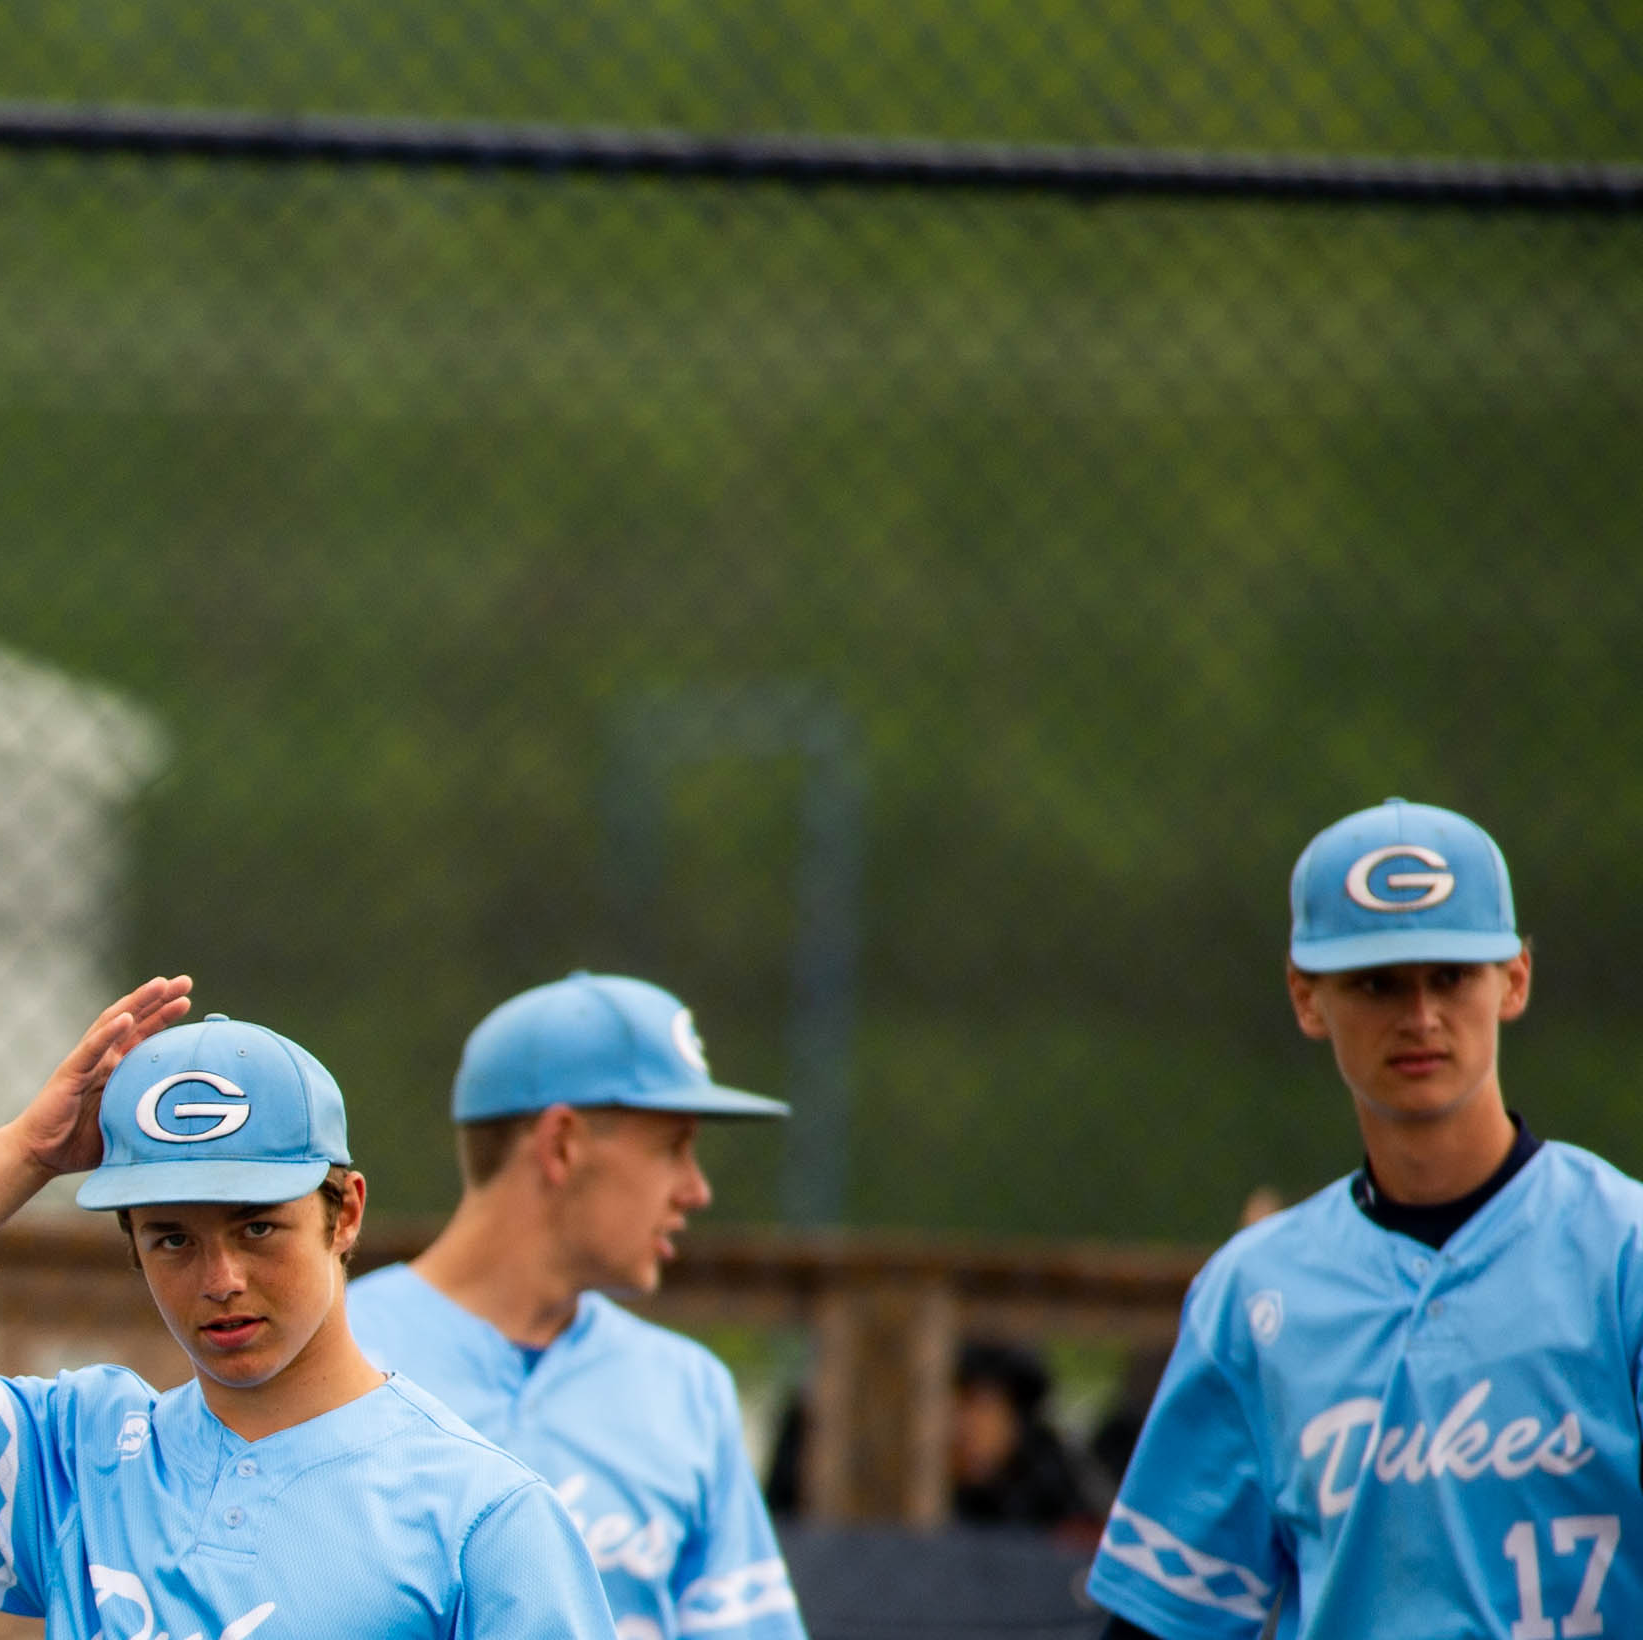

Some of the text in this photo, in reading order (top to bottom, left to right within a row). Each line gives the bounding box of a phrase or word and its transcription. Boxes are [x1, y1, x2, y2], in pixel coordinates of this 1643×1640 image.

[1345, 844, 1455, 913] G
[135, 1069, 251, 1144] G
[1301, 1379, 1595, 1518] Dukes
